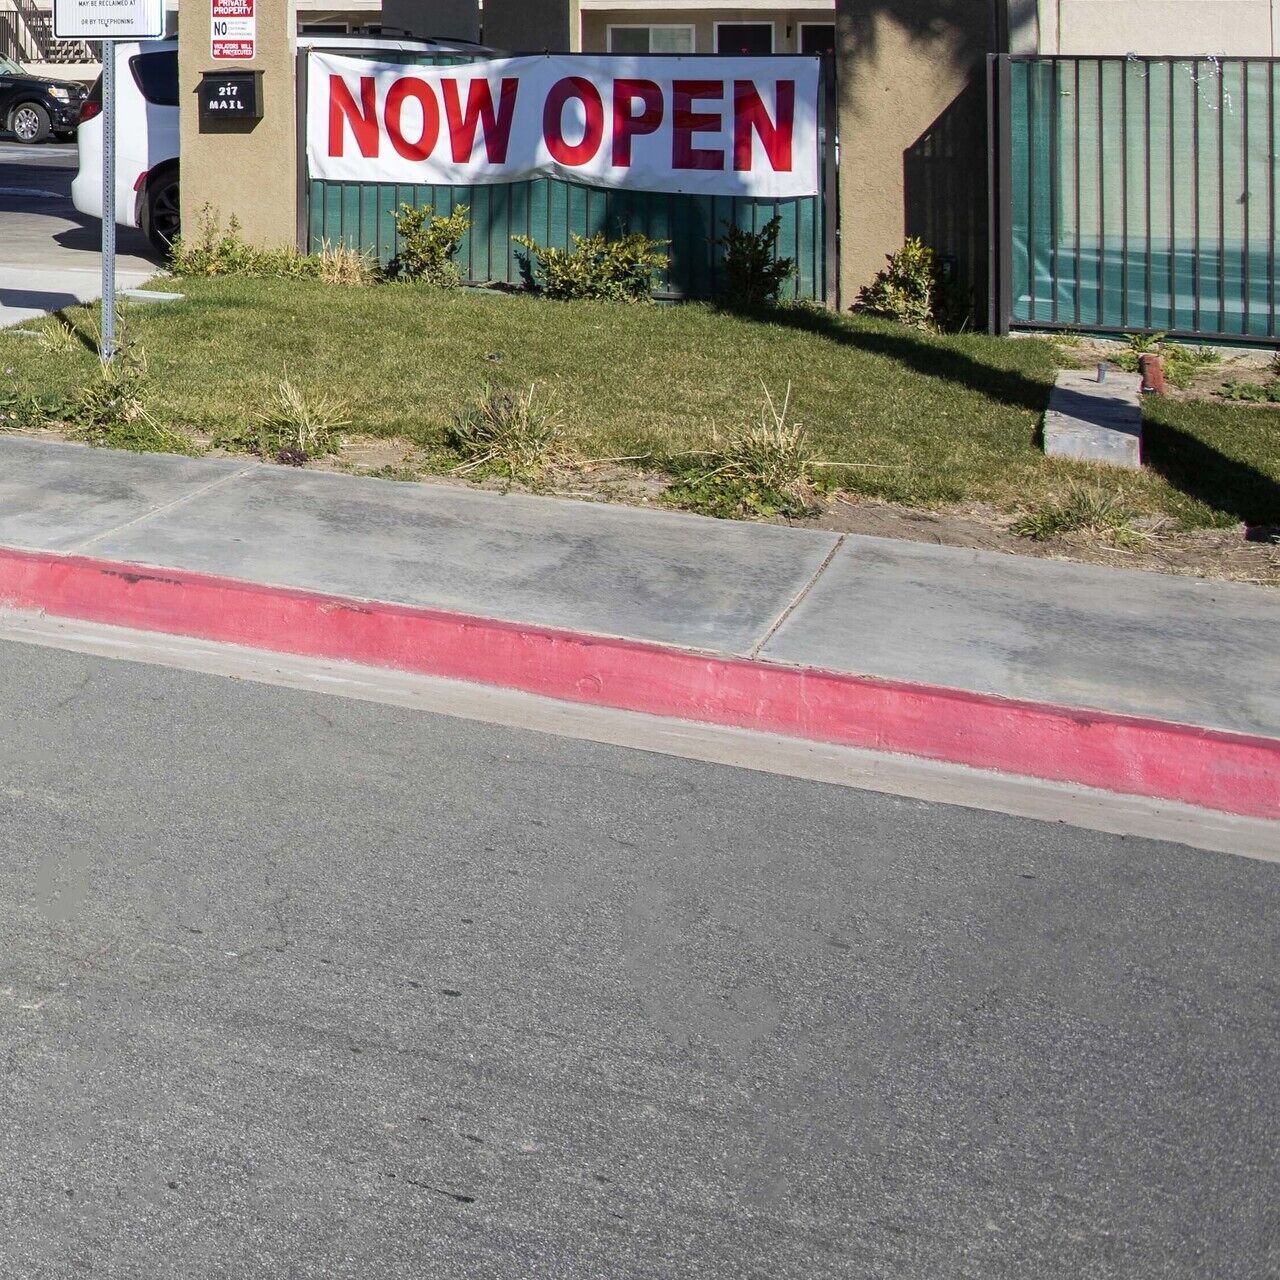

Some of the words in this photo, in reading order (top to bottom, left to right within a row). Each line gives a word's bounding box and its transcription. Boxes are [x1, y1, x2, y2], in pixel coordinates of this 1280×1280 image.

[214, 22, 227, 36] NO
[218, 86, 238, 96] 217
[209, 100, 244, 109] MAIL
[328, 74, 519, 164] NOW
[543, 76, 795, 172] OPEN
